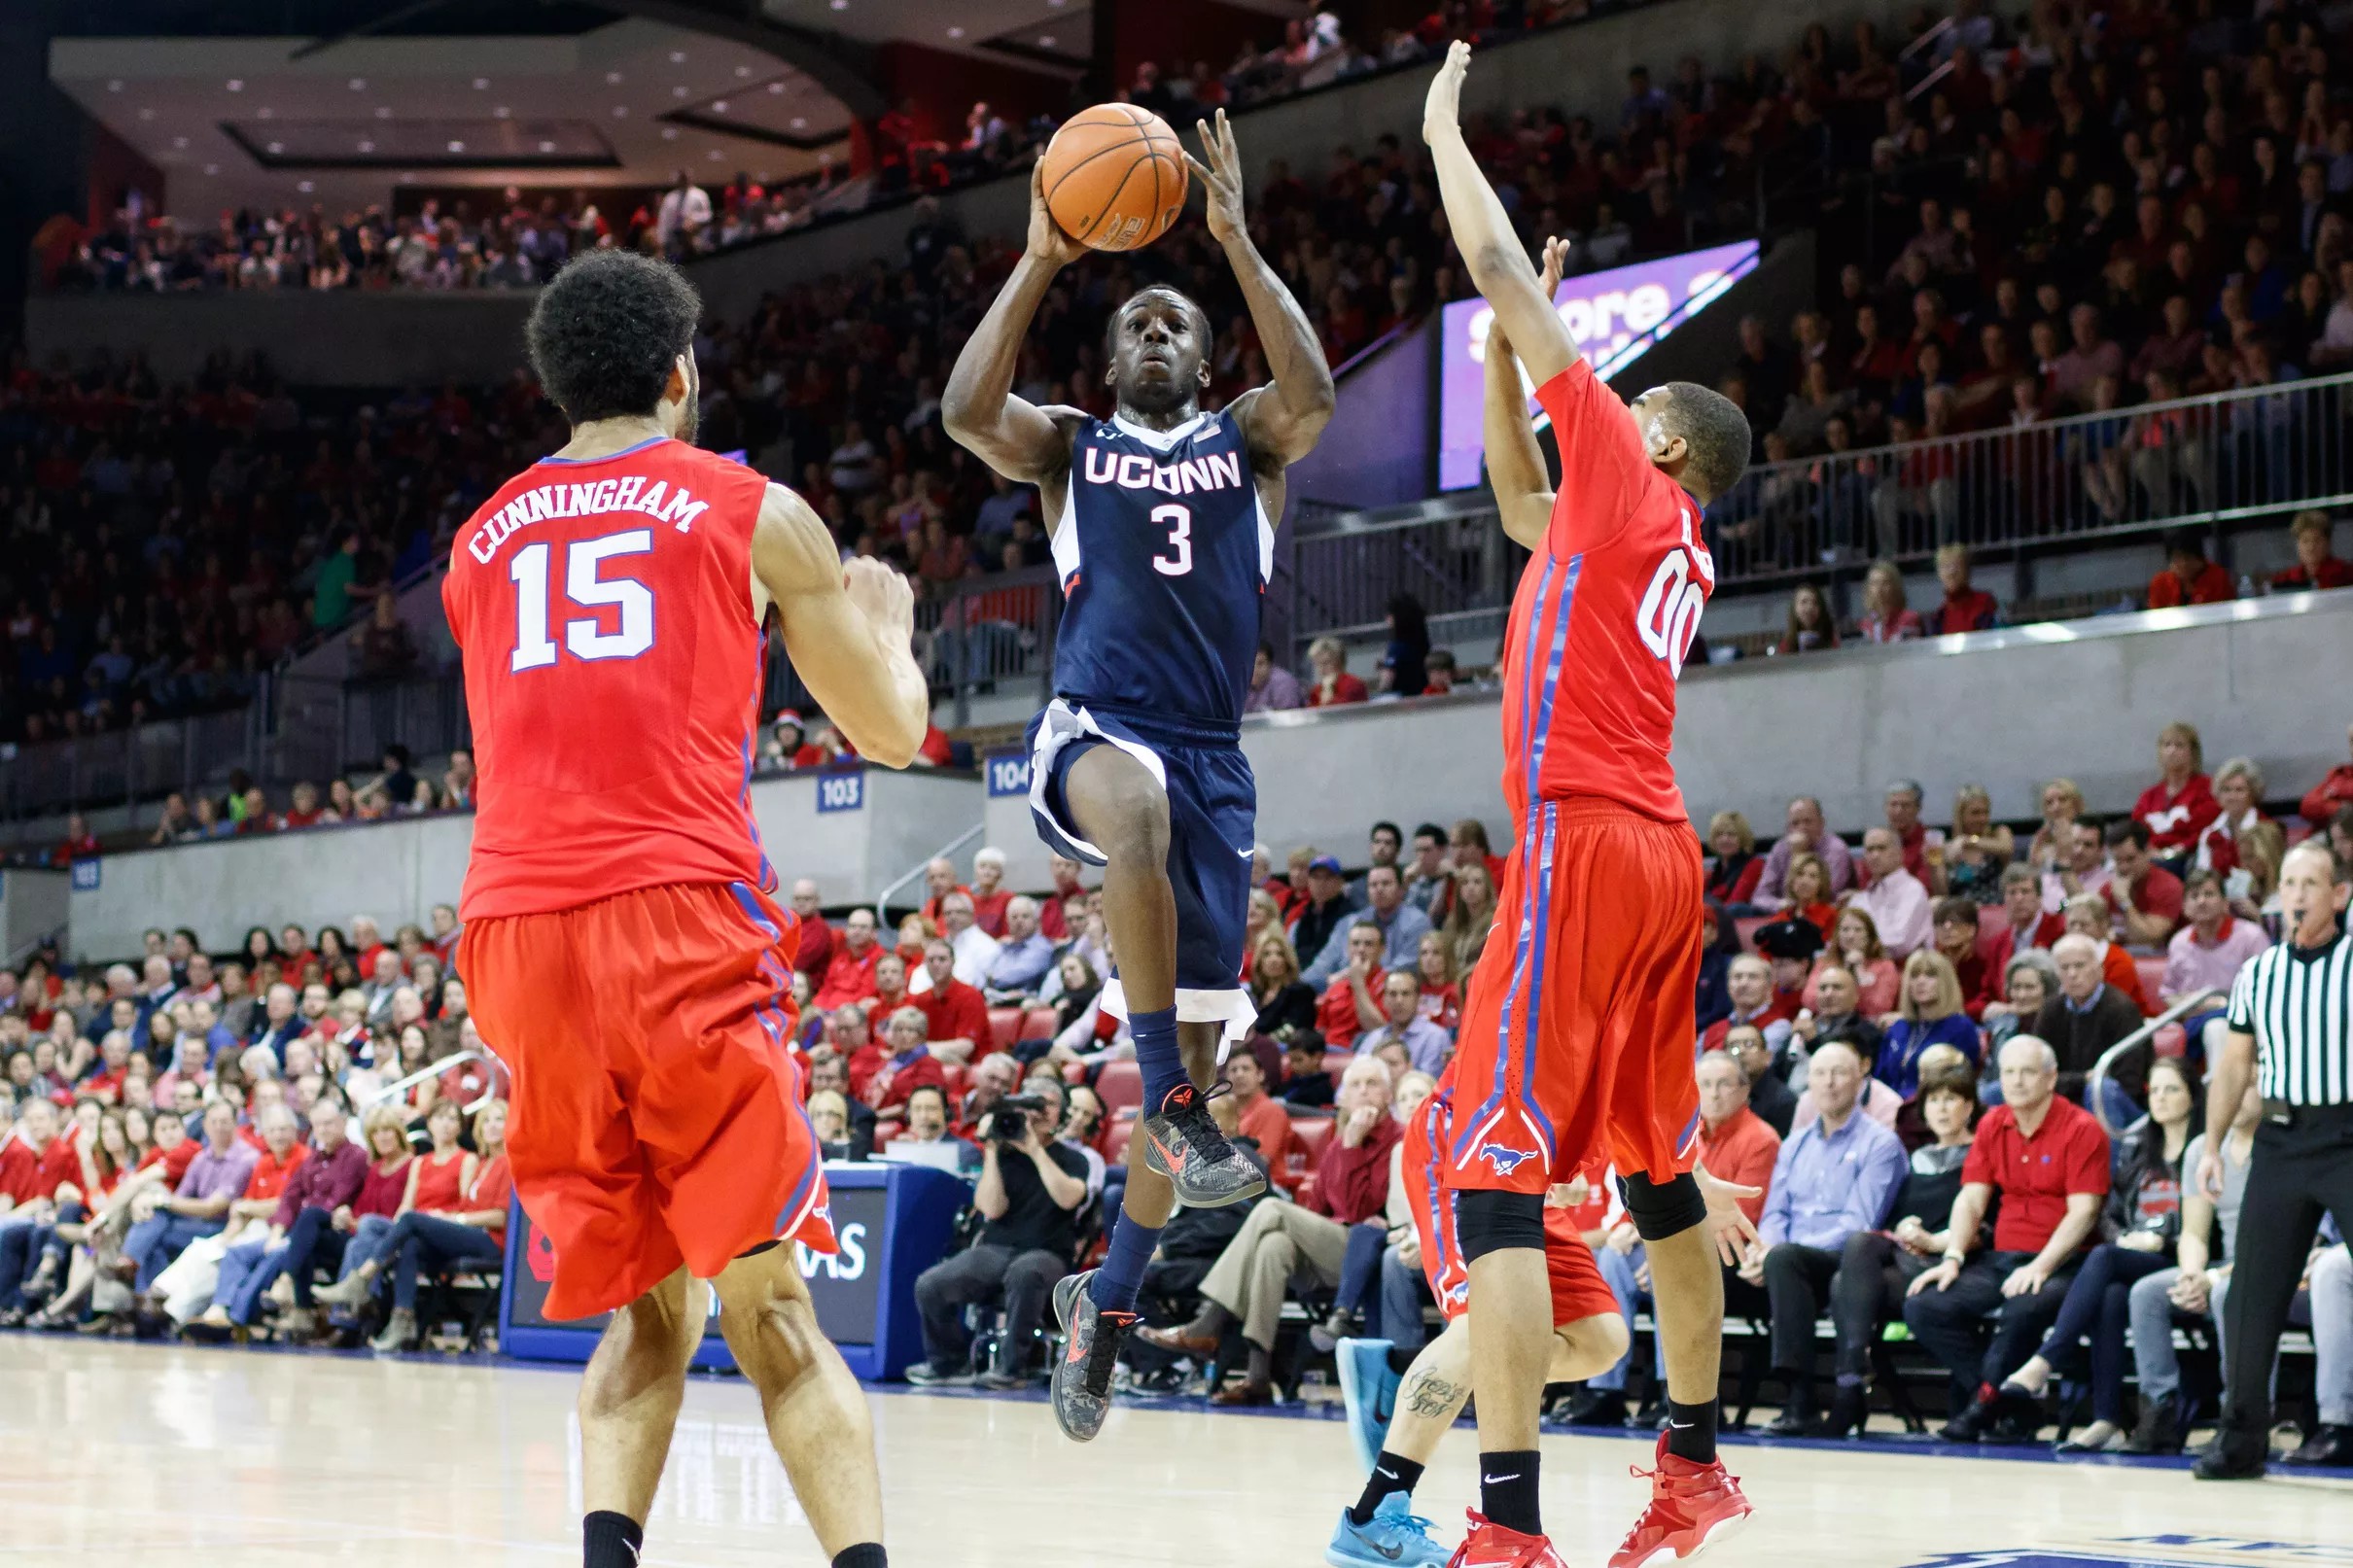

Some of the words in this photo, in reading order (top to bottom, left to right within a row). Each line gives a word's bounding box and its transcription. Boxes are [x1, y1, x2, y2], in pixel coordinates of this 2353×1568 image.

[1084, 446, 1243, 496] UCONN
[468, 475, 709, 565] CUNNINGHAM
[1150, 504, 1194, 576] 3
[509, 527, 654, 674] 15
[1635, 546, 1705, 681] 00
[824, 777, 860, 807] 103
